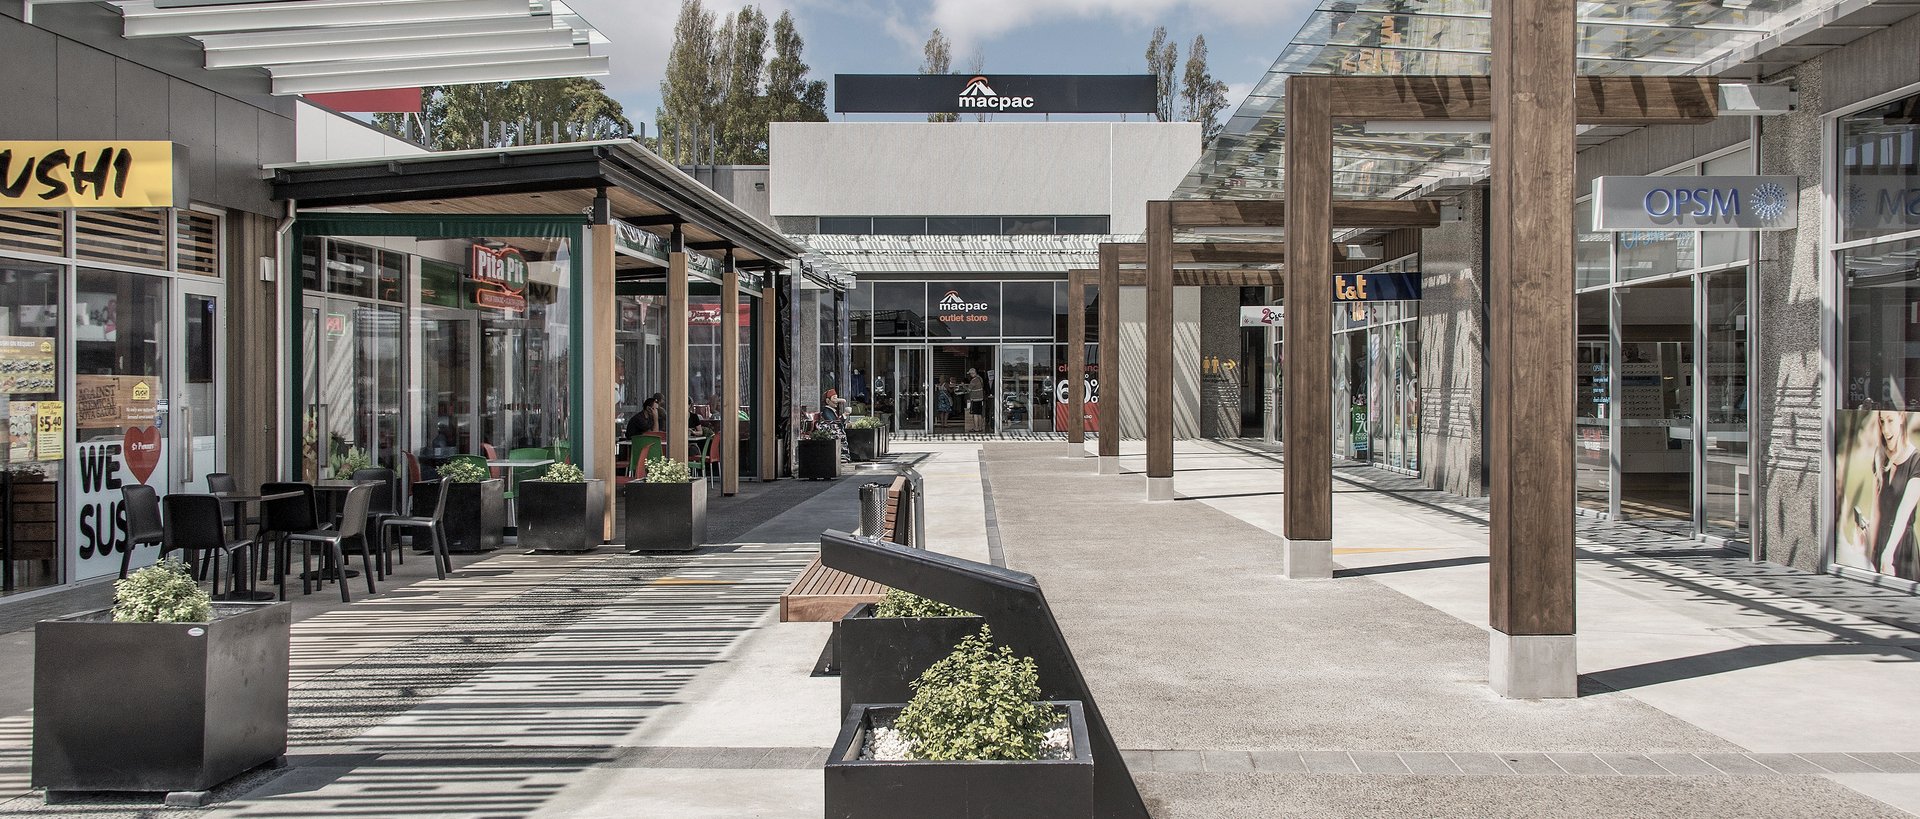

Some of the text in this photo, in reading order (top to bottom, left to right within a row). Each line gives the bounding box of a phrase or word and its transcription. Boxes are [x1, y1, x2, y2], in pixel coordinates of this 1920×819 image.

[959, 96, 1034, 111] macpac
[1644, 188, 1740, 217] OPSM
[478, 249, 524, 284] Pita Pit
[1335, 274, 1367, 300] t&t
[939, 302, 988, 313] macpac
[939, 314, 988, 322] outlet store
[79, 385, 116, 399] AGAINST
[1355, 412, 1366, 421] 30
[80, 444, 122, 494] WE
